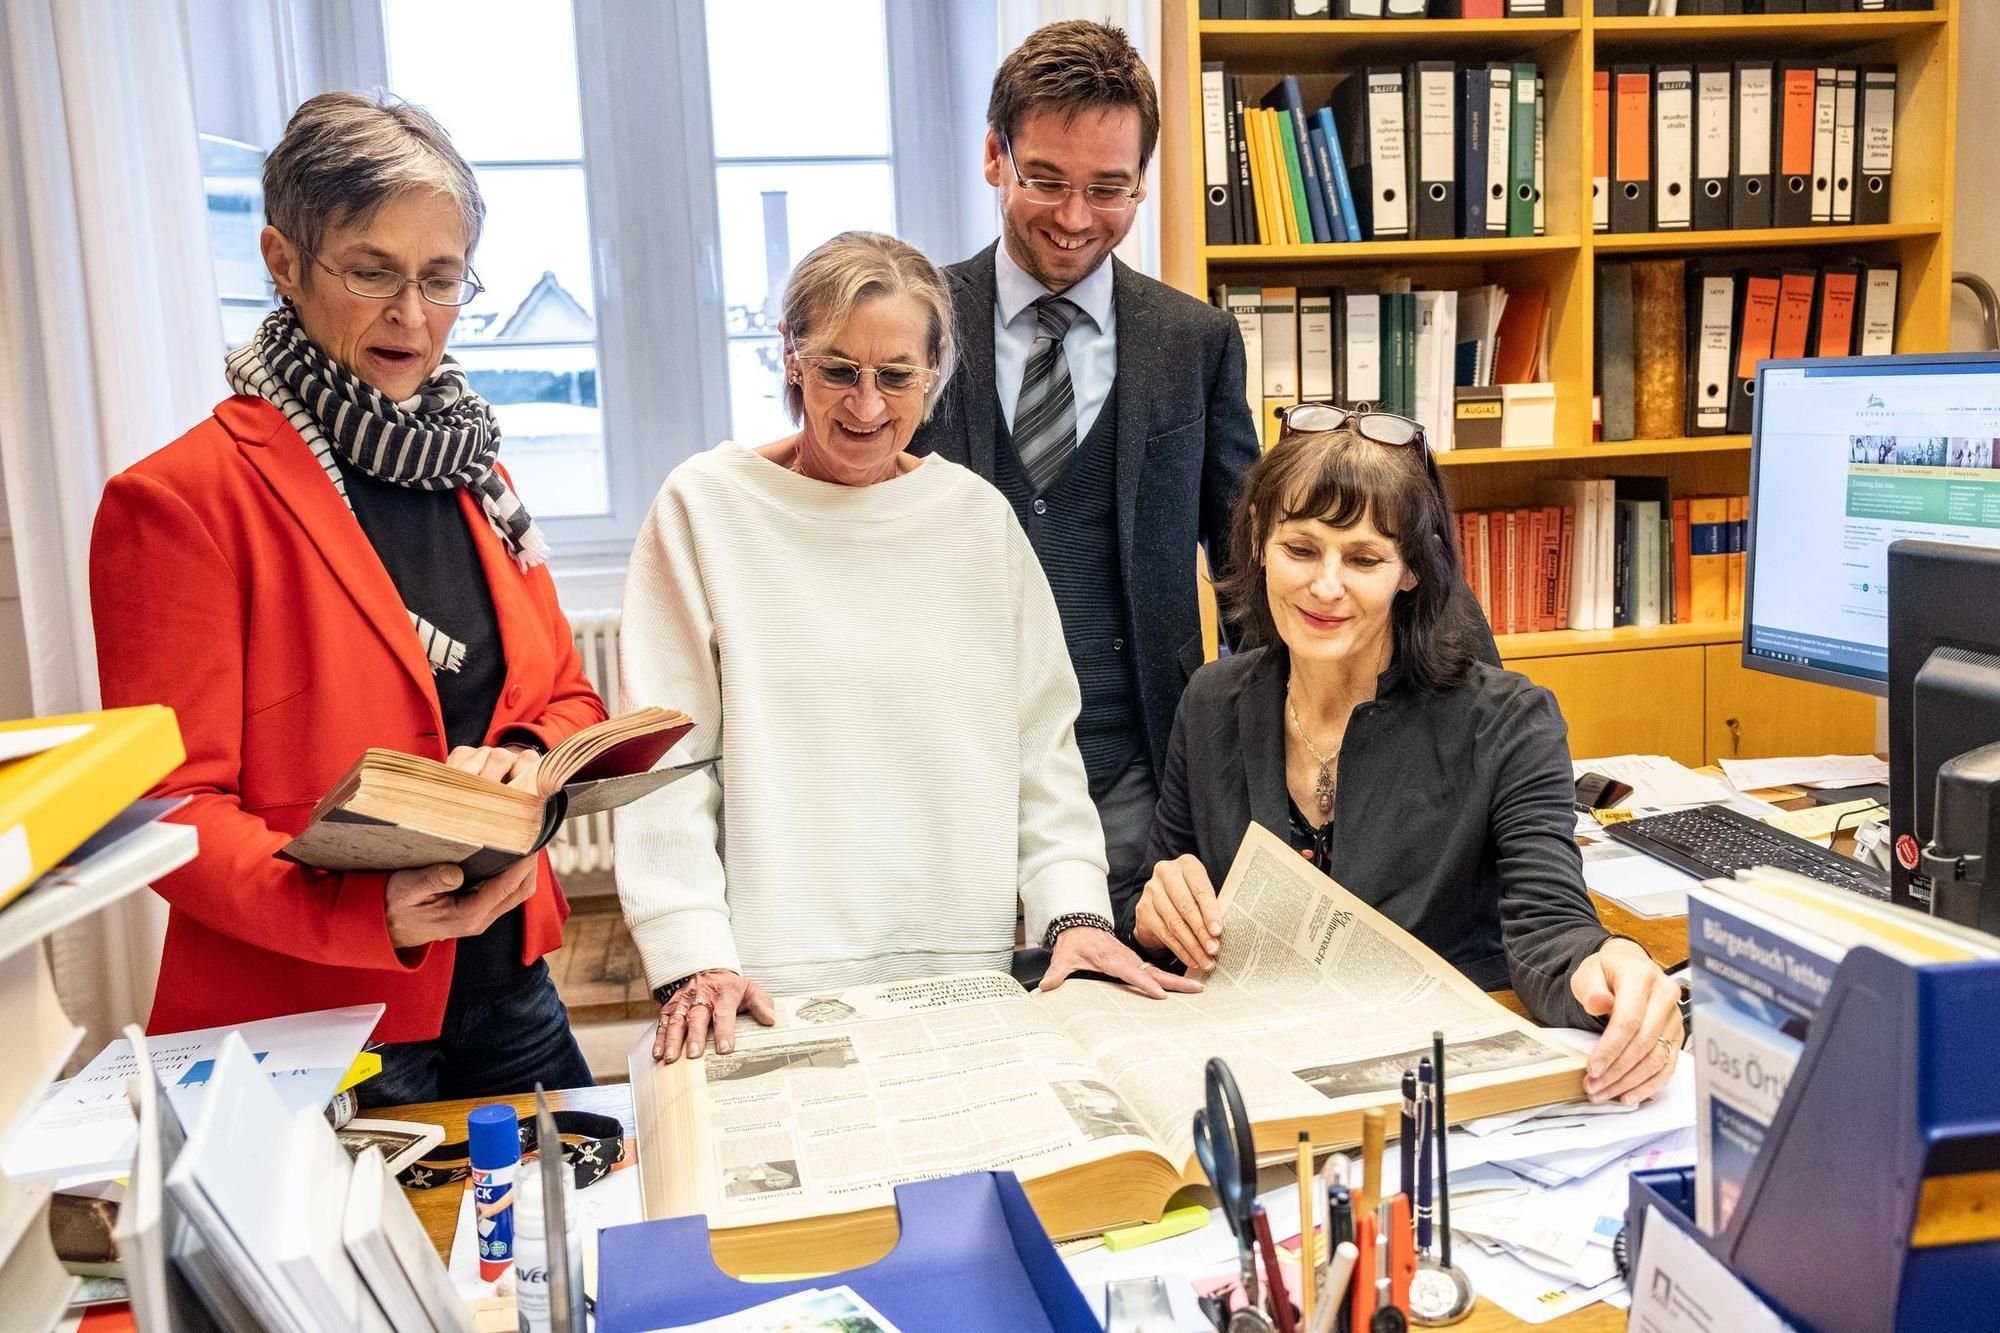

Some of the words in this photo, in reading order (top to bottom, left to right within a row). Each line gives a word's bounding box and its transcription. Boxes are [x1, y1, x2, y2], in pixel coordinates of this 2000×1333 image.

[1464, 406, 1496, 414] AUGIAS
[1314, 910, 1342, 965] Mitternacht
[1340, 911, 1353, 928] Vor
[1702, 917, 1786, 974] Bürgerbuch
[1707, 1038, 1742, 1080] Das
